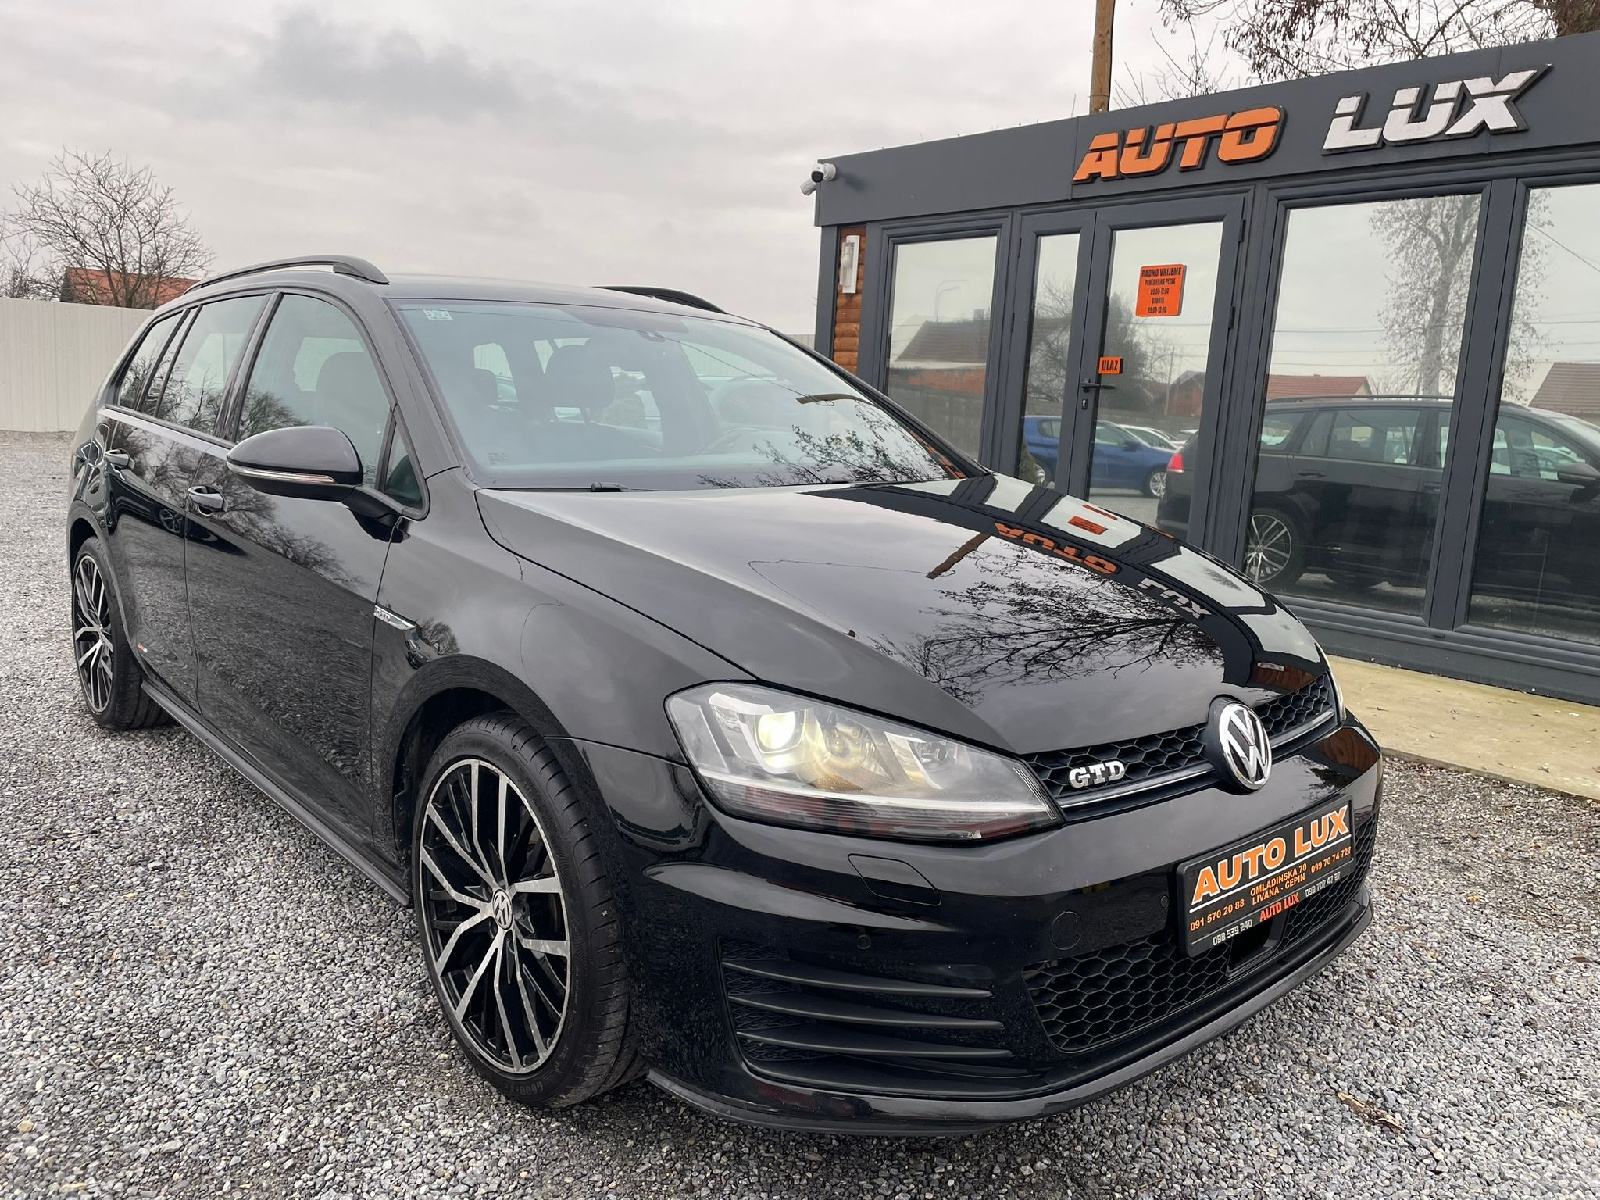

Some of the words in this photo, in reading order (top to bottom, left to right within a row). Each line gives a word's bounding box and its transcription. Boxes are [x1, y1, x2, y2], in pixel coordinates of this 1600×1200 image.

[1073, 106, 1284, 181] AUTO
[1322, 69, 1540, 152] LUX
[1069, 760, 1125, 789] GTD
[1190, 837, 1287, 906] AUTO
[1294, 805, 1350, 859] LUX
[1250, 868, 1298, 896] OMLADINSKA
[1251, 886, 1280, 905] LIVANA
[1190, 918, 1204, 931] 091
[1223, 904, 1234, 916] 20
[1259, 900, 1282, 923] AUTO
[1284, 891, 1300, 910] LUX
